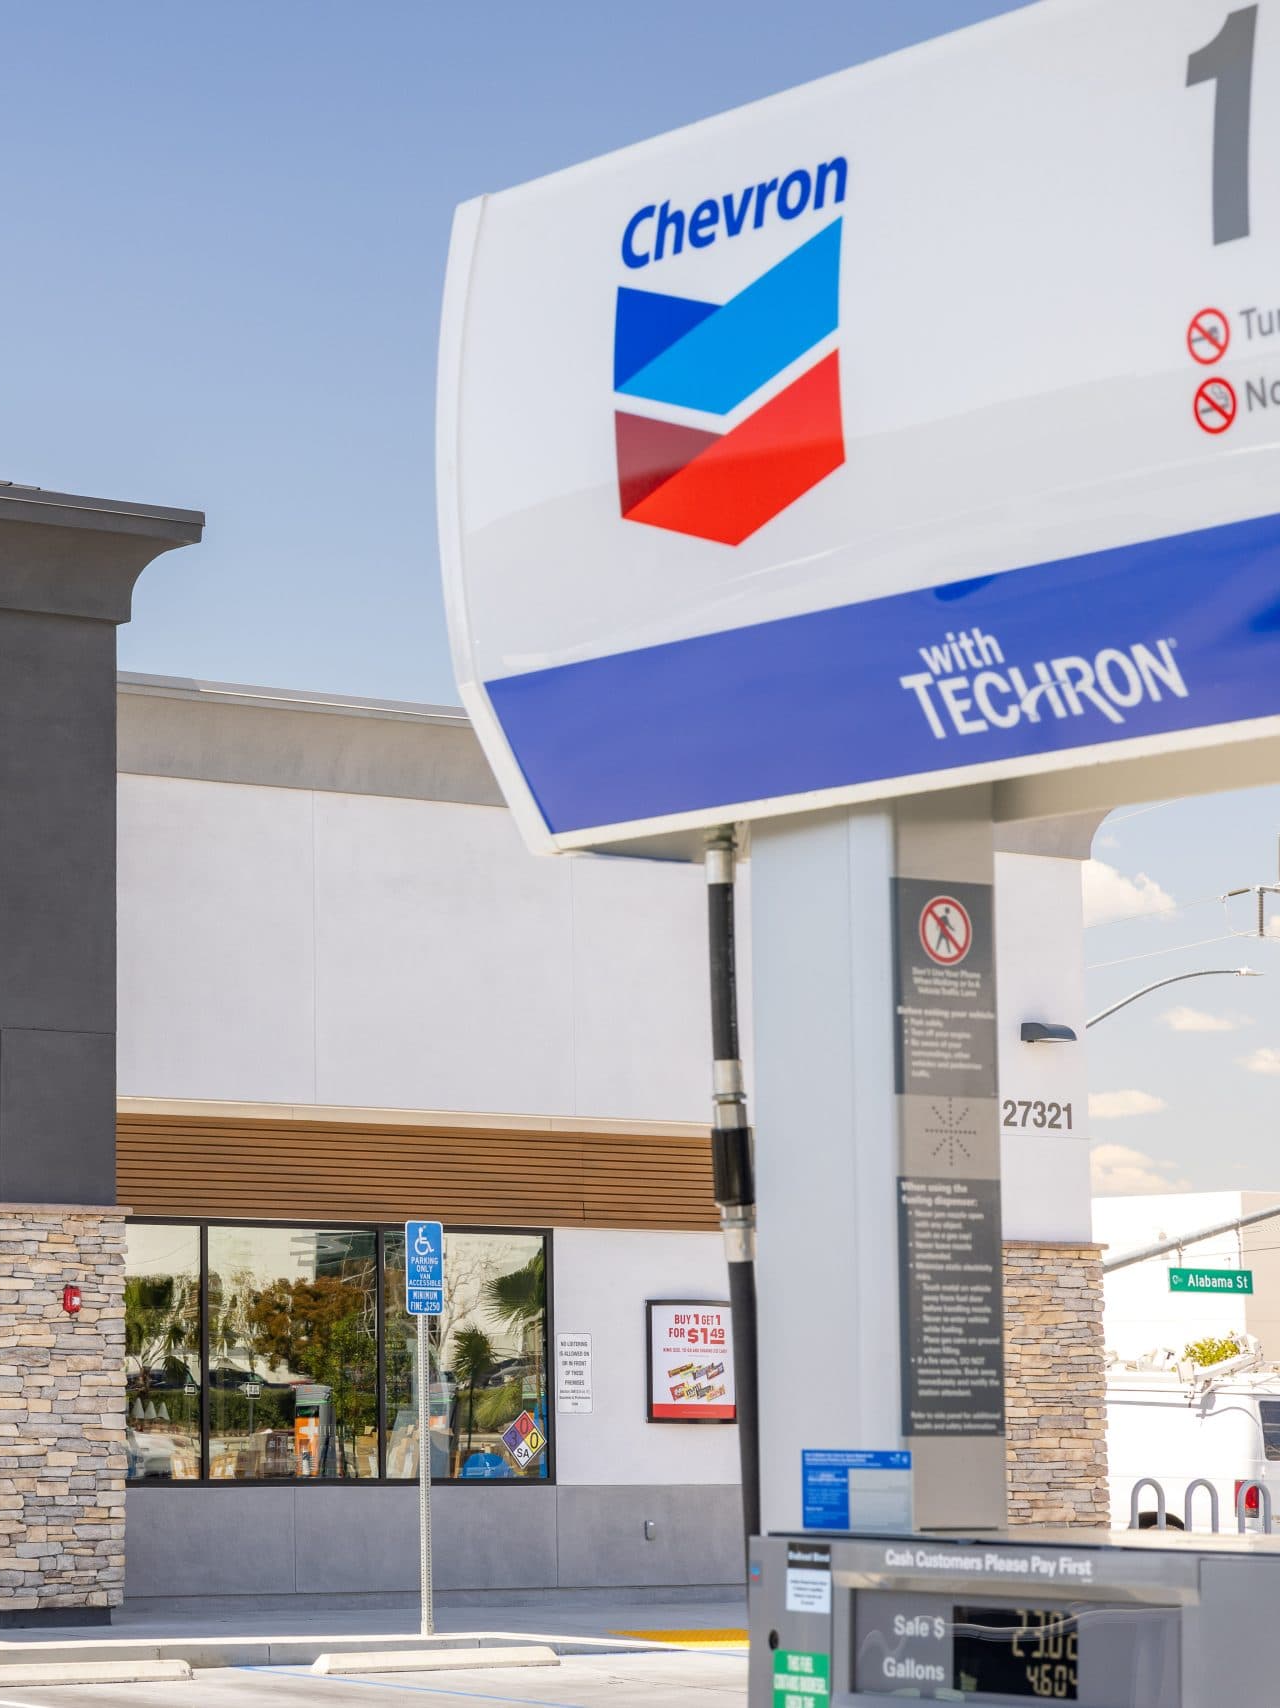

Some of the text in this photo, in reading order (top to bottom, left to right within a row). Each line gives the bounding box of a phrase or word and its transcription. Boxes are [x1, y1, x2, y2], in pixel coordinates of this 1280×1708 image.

[1185, 4, 1261, 247] 1
[620, 155, 849, 270] Chevron
[1237, 306, 1280, 341] Tu
[918, 627, 1005, 676] with
[1002, 1099, 1073, 1130] 27321
[410, 1256, 439, 1265] PARKING
[416, 1265, 433, 1273] ONLY
[409, 1279, 441, 1287] ACCESSIBLE
[1187, 1273, 1249, 1289] Alabama St
[412, 1291, 438, 1300] MINIMUM
[410, 1301, 441, 1312] FINE $250
[674, 1313, 721, 1326] BUY 1 GET 1
[668, 1328, 685, 1338] FOR
[520, 1418, 529, 1435] 0
[509, 1431, 539, 1449] 3 0
[516, 1447, 530, 1459] SA
[885, 1549, 1093, 1578] Cash Customers Please Pay First
[893, 1614, 945, 1640] Sale $
[882, 1656, 945, 1682] Gallons
